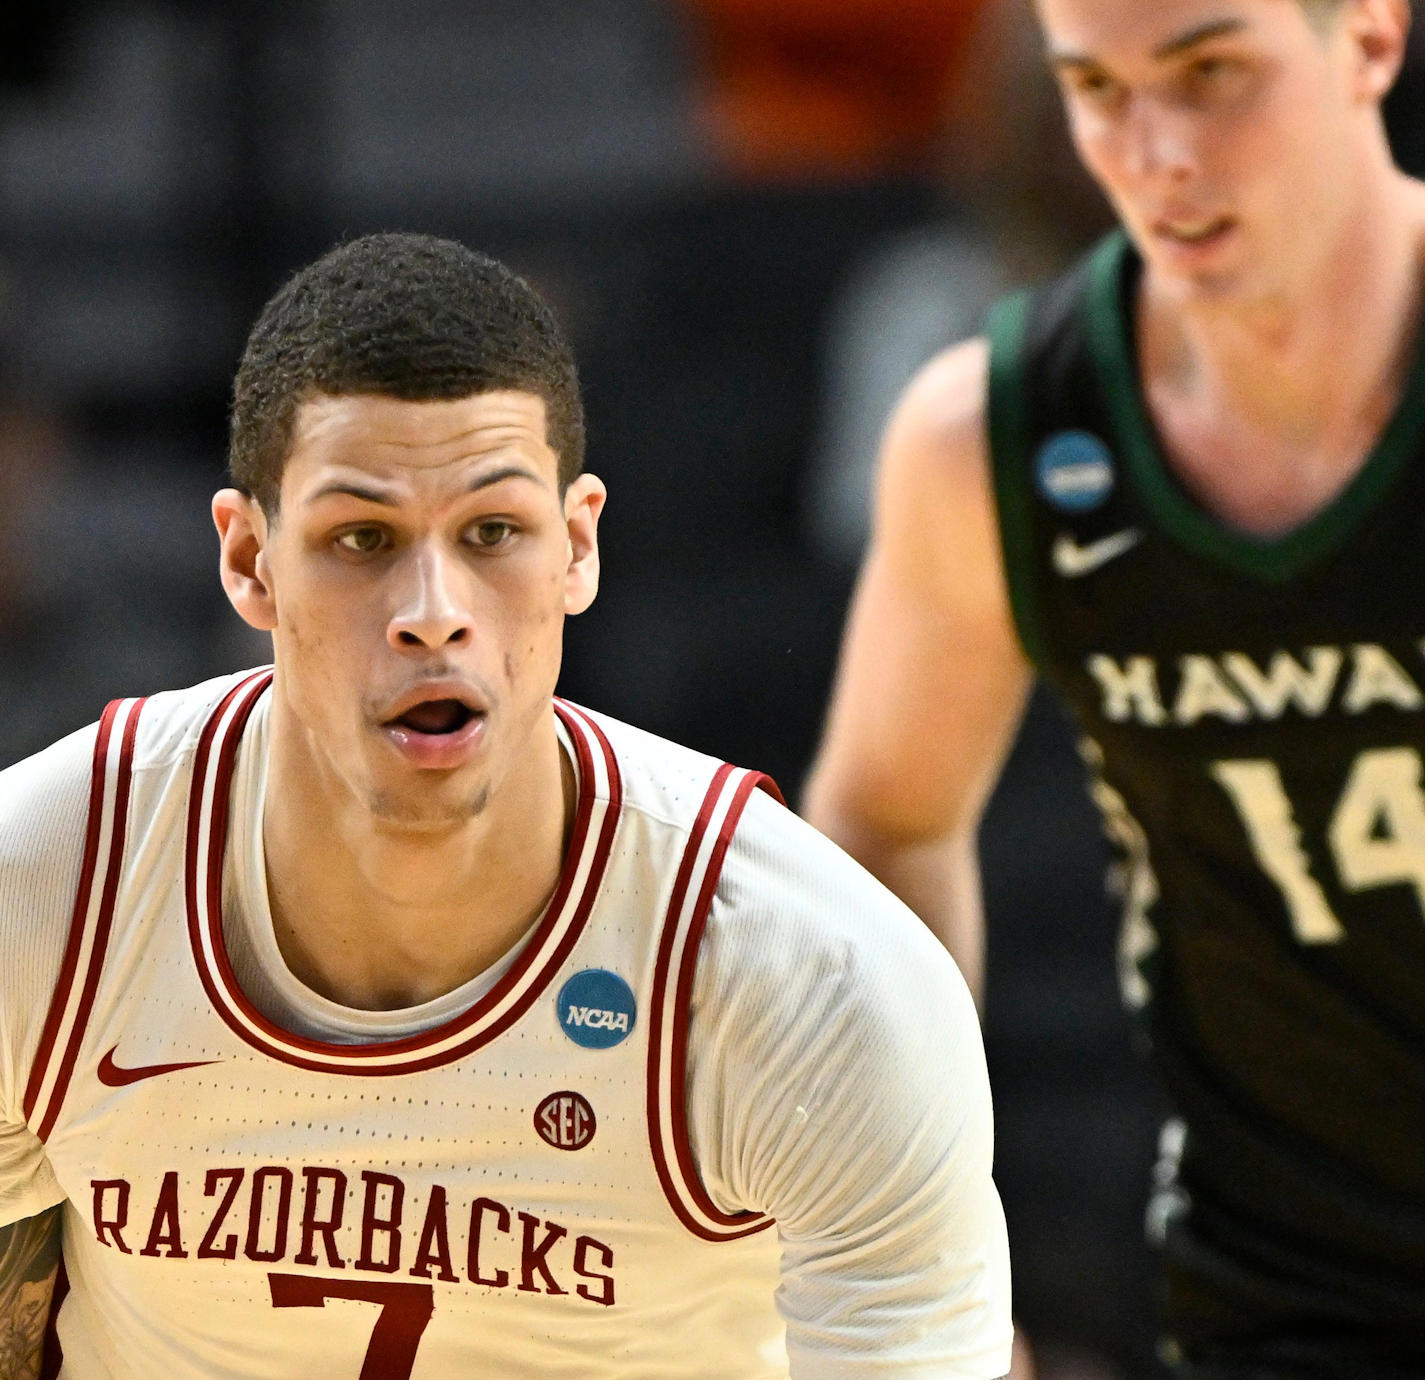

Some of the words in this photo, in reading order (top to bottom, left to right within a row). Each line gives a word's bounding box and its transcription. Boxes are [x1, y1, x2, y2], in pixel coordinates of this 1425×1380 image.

[566, 1005, 629, 1033] NCAA
[539, 1097, 589, 1146] SEC
[90, 1165, 616, 1307] RAZORBACKS
